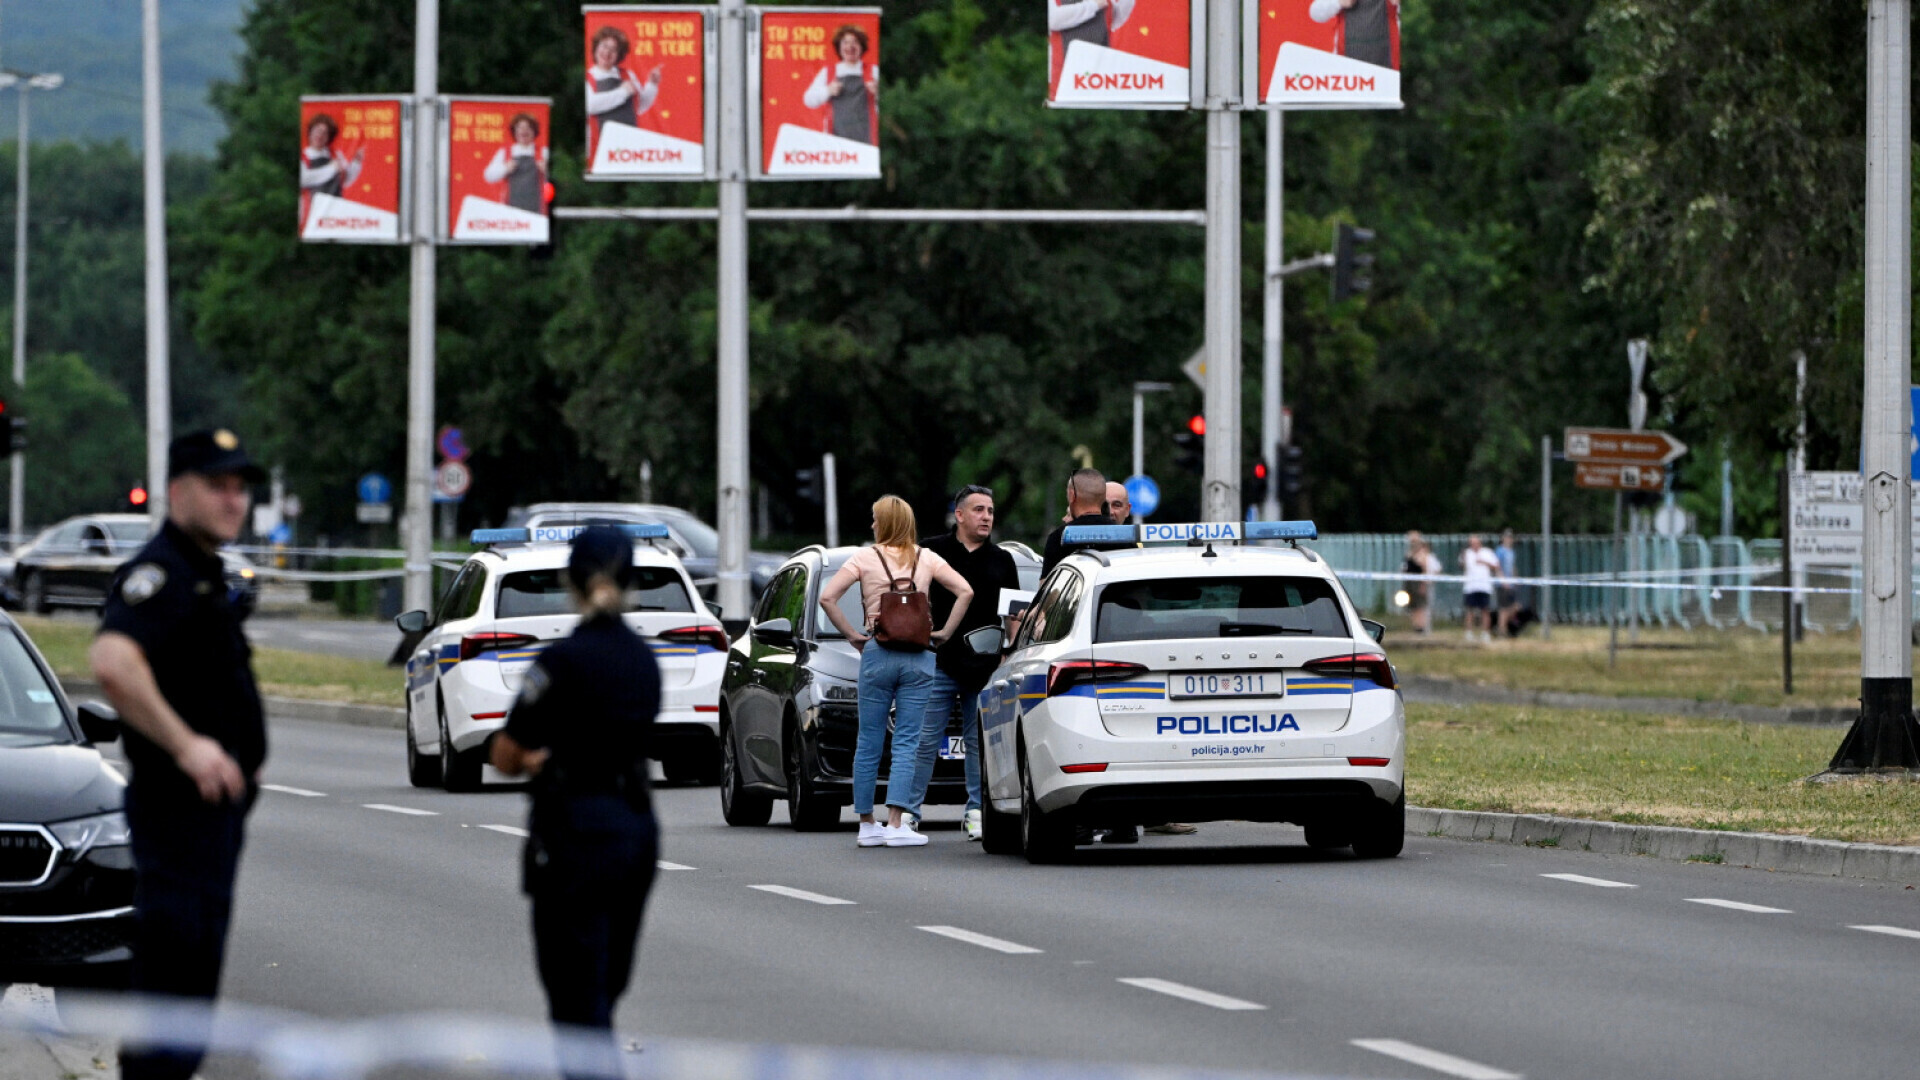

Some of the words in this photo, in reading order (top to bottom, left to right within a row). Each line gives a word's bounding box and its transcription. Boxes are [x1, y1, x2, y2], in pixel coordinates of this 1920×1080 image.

[1074, 73, 1164, 90] KONZUM
[1284, 75, 1375, 92] KONZUM
[607, 149, 683, 163] KONZUM
[784, 151, 858, 165] KONZUM
[1795, 514, 1850, 528] Dubrava
[1146, 524, 1235, 540] POLICIJA
[1184, 675, 1218, 694] 010
[1233, 675, 1265, 692] 311
[1157, 713, 1300, 735] POLICIJA
[1191, 744, 1266, 757] policija.gov.hr
